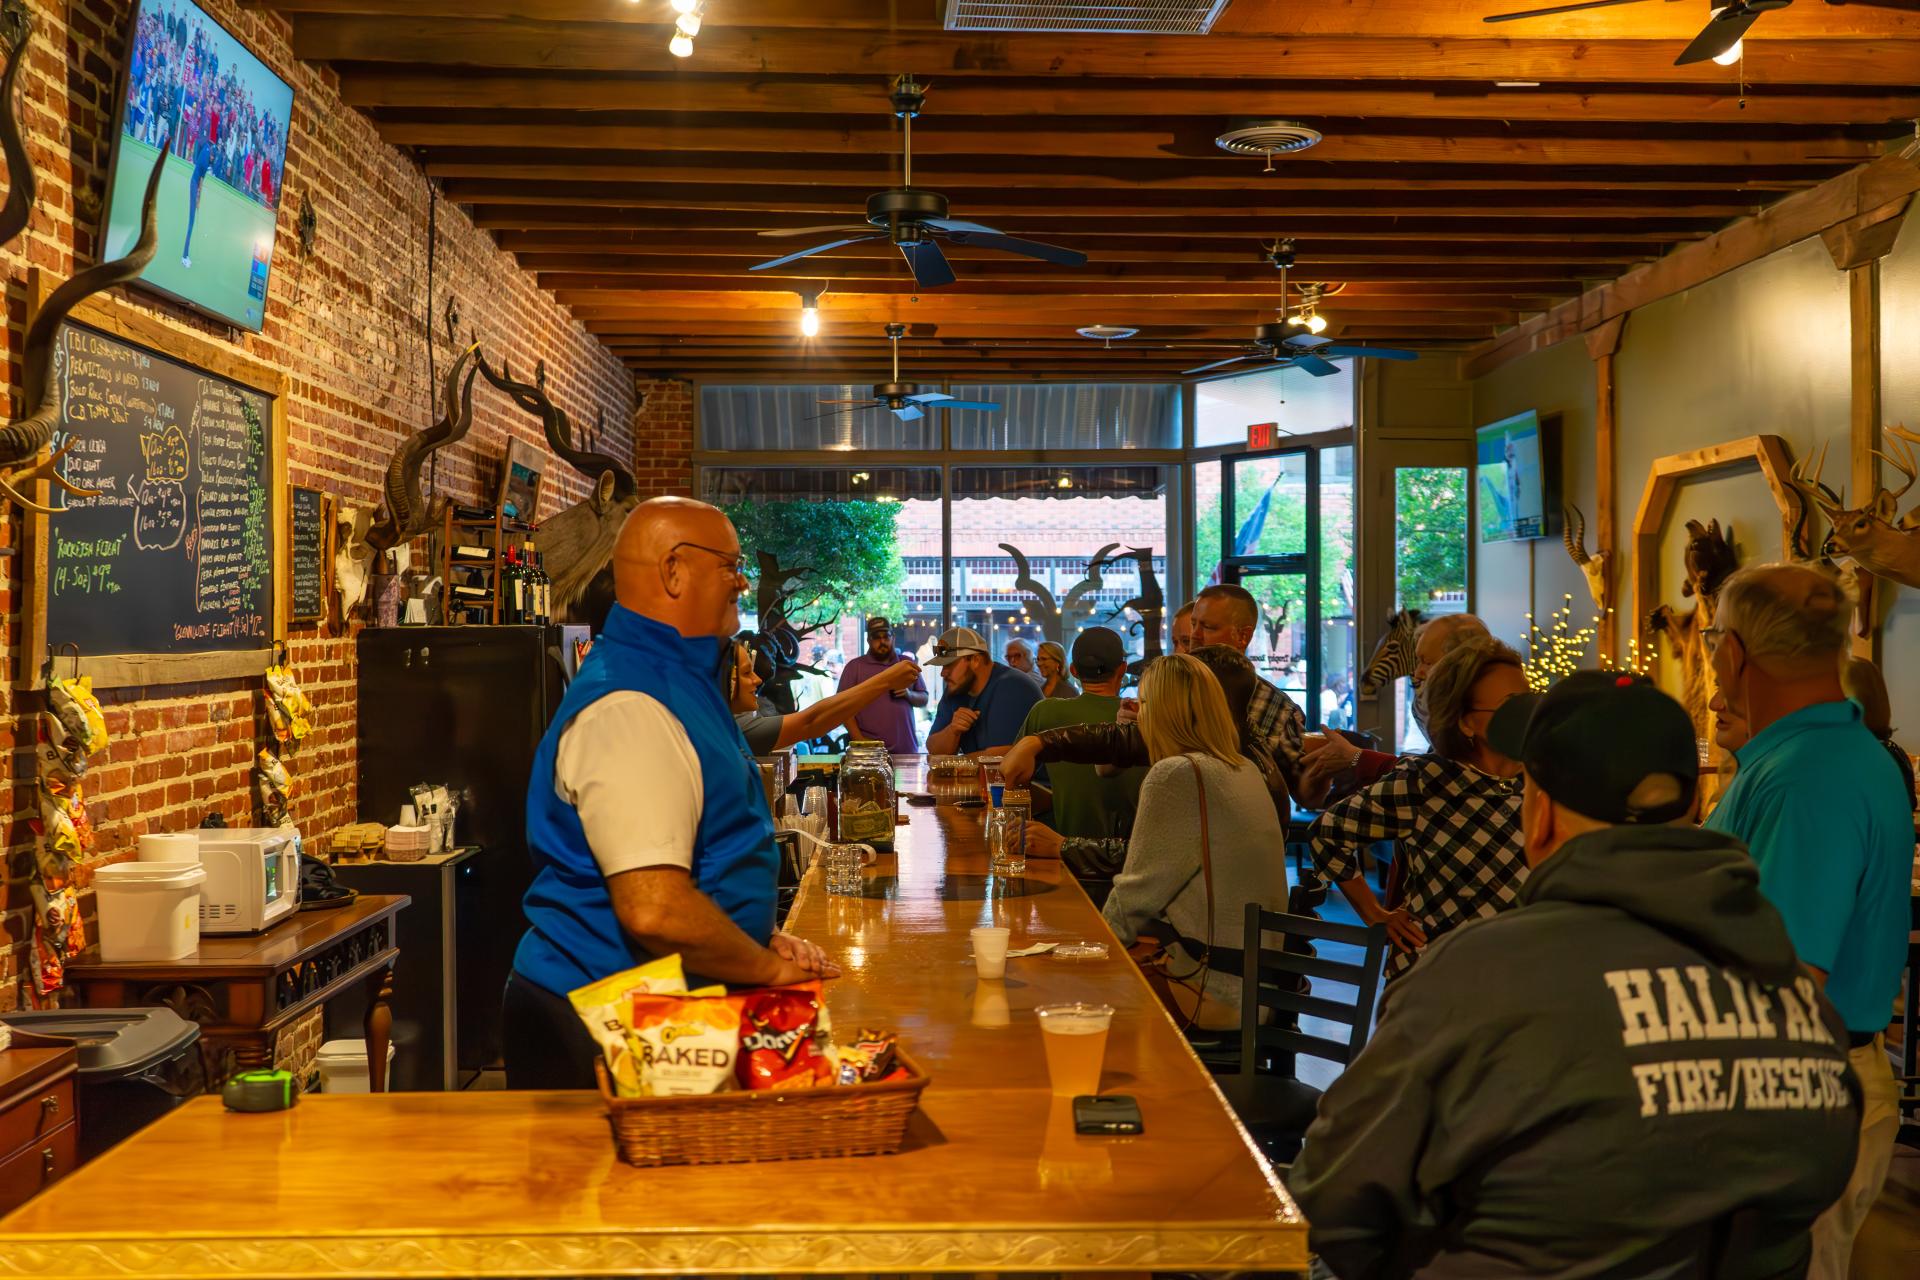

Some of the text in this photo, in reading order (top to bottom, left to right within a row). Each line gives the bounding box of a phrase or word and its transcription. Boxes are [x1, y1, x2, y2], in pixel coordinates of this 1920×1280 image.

[1251, 424, 1270, 448] EXIT
[1604, 966, 1835, 1047] HALIFAX
[643, 1046, 730, 1069] BAKED
[1632, 1058, 1848, 1118] FIRE/RESCUE
